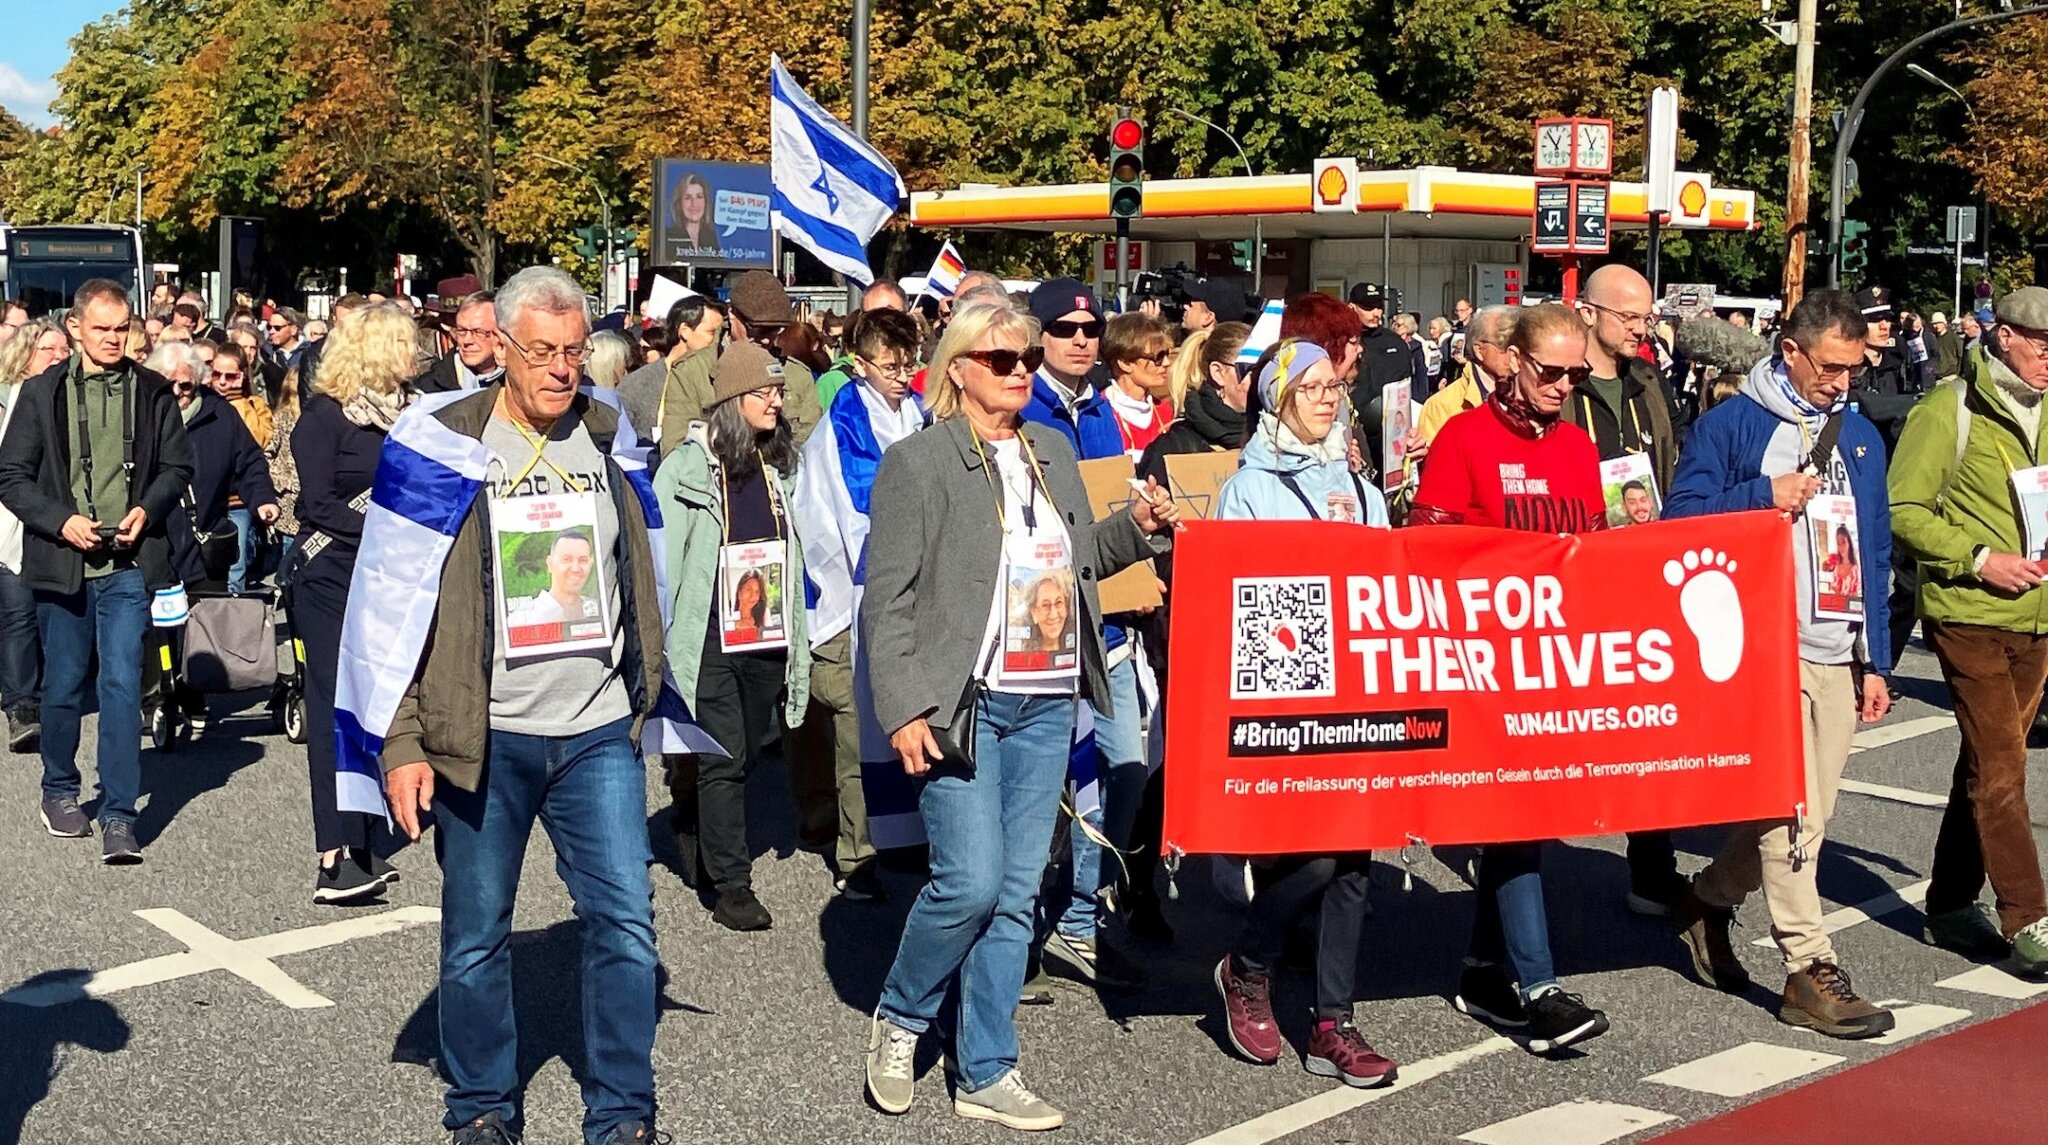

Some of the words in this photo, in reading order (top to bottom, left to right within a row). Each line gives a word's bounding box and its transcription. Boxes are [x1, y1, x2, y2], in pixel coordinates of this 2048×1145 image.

[730, 195, 746, 206] DAS
[747, 197, 767, 209] PLUS
[1499, 463, 1526, 479] BRING
[1502, 479, 1526, 495] THEM
[1525, 479, 1550, 495] HOME
[1346, 574, 1450, 633] RUN
[1456, 575, 1566, 632] FOR
[1348, 635, 1501, 695] THEIR
[1509, 628, 1675, 692] LIVES
[1233, 715, 1442, 752] #BringThemHomeNow
[1503, 703, 1678, 737] RUN4LIVES.ORG
[1224, 778, 1250, 795] Für
[1254, 778, 1279, 794] die
[1281, 773, 1367, 793] Freilassung
[1372, 773, 1395, 789] der
[1399, 769, 1494, 788] verschleppten
[1496, 768, 1531, 783] Geiseln
[1533, 765, 1562, 782] durch
[1565, 764, 1584, 779] die
[1585, 756, 1705, 777] Terrororganisation
[1707, 752, 1752, 769] Hamas
